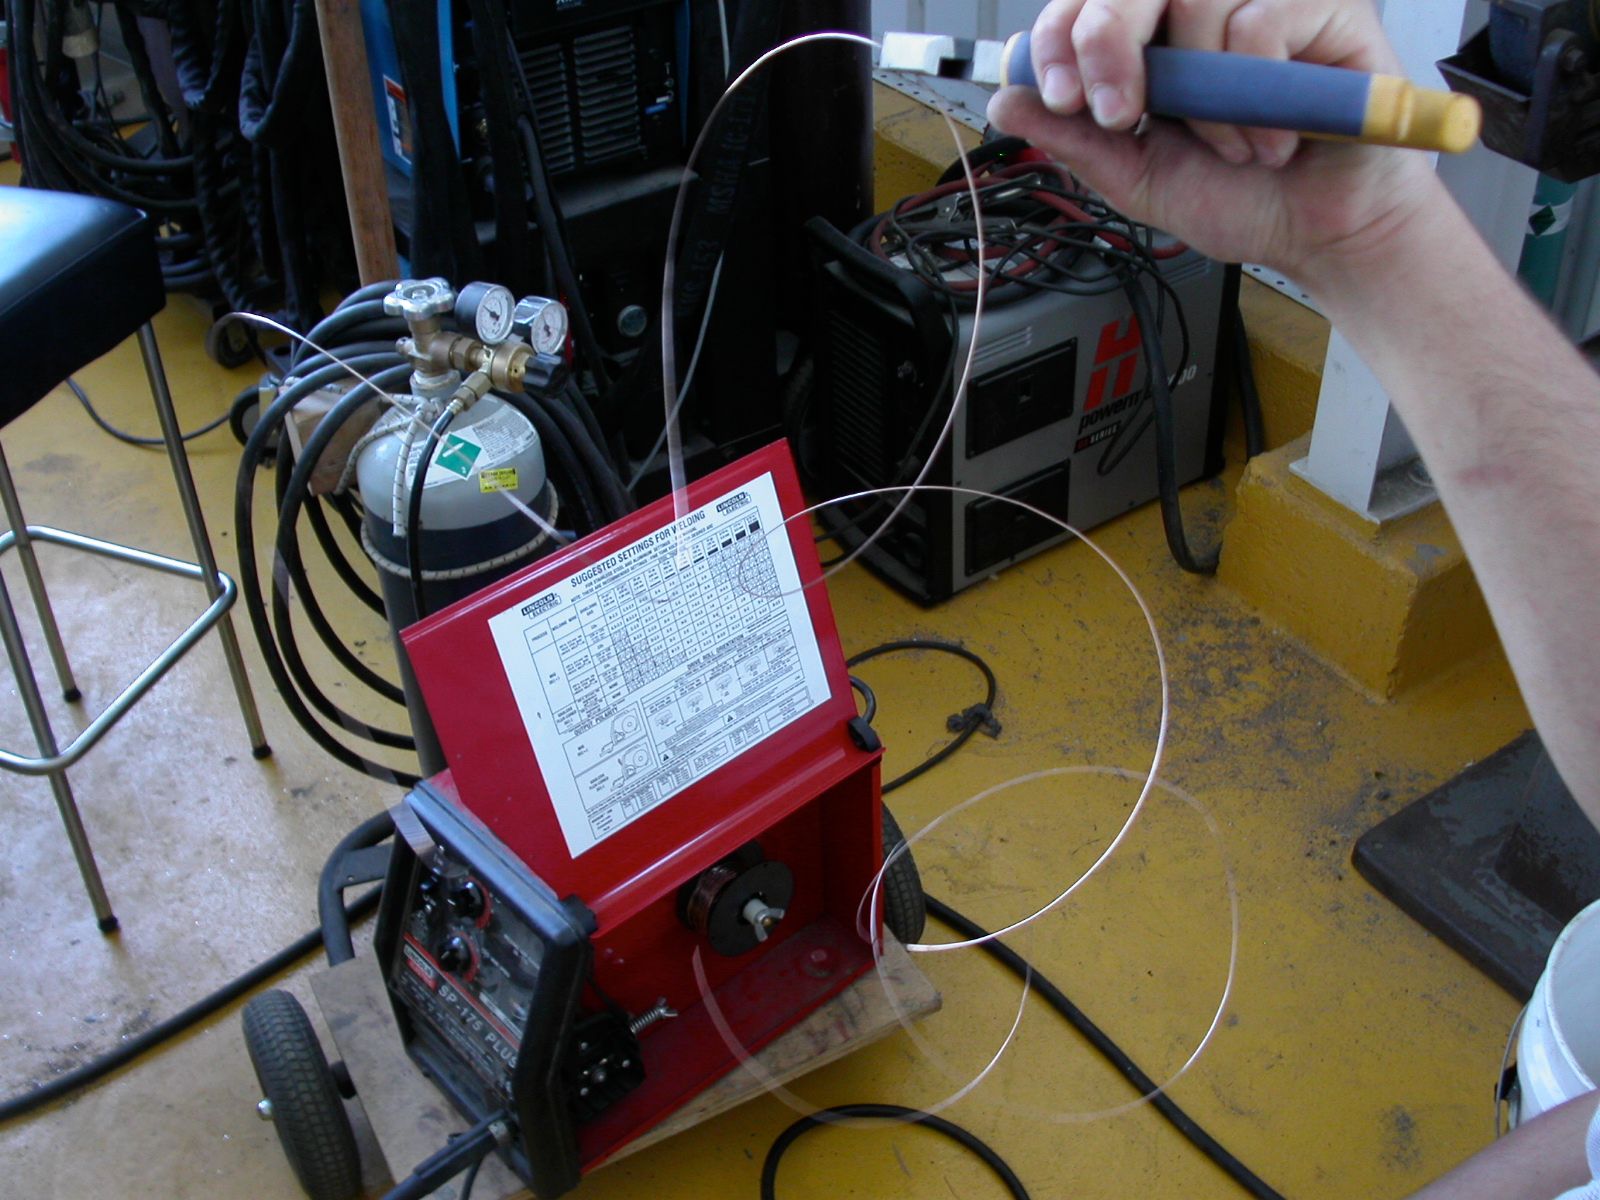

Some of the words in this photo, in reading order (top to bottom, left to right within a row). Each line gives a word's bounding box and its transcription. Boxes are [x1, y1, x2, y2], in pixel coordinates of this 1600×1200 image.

[716, 491, 745, 512] LINCOLN
[724, 496, 750, 515] ELECTRIC
[569, 555, 618, 588] SUGGESTED
[616, 536, 655, 563] SETTINGS
[654, 527, 671, 543] FOR
[521, 592, 554, 616] LINCOLN
[531, 597, 560, 618] ELECTRIC
[439, 985, 483, 1030] SP-175
[484, 1032, 517, 1069] PLUS
